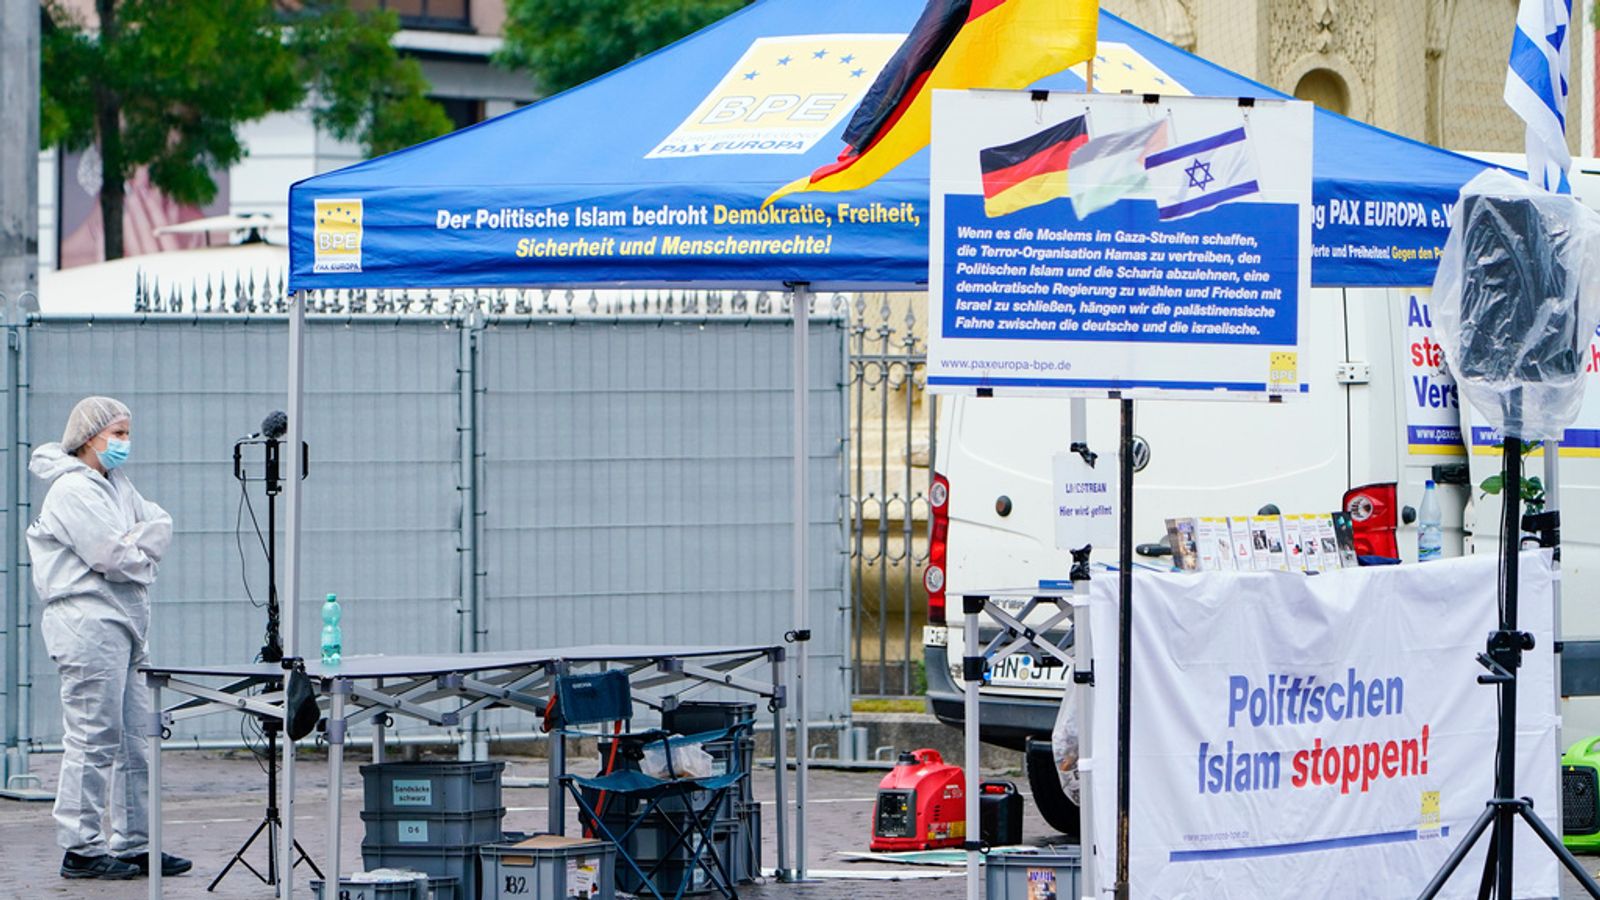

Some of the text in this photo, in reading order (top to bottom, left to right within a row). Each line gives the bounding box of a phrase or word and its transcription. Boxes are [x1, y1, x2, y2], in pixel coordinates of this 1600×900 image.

[699, 93, 848, 125] BPE
[658, 140, 804, 153] PAX EUROPA
[436, 202, 921, 229] Der Politische Islam bedroht Demokratie, Freiheit,
[1330, 199, 1360, 225] PAX
[1364, 201, 1427, 228] EUROPA
[319, 232, 357, 250] BPE
[515, 235, 832, 257] Sicherheit und Menschenrechte!
[957, 226, 1258, 248] Wenn es die Moslems im Gaza-Streifen schaffen,
[957, 245, 1261, 265] die Terror-Organisation Hamas zu vertreiben, den
[1332, 245, 1347, 257] und
[1348, 245, 1390, 259] Freiheiten!
[1391, 246, 1416, 262] Gegen
[1418, 247, 1433, 259] den
[956, 262, 1270, 284] Politischen Islam und die Scharia abzulehnen, eine
[956, 281, 1282, 300] demokratische Regierung zu wählen und Frieden mit
[955, 299, 1275, 318] Israel zu schließen, hängen wir die palästinensische
[955, 316, 1260, 336] Fahne zwischen die deutsche und die israelische.
[941, 359, 1072, 372] www.paxeuropa-bpe.de
[993, 656, 1019, 678] HN
[1228, 668, 1403, 728] Politischen
[1199, 724, 1429, 794] Islam stoppen!
[504, 875, 529, 895] B2
